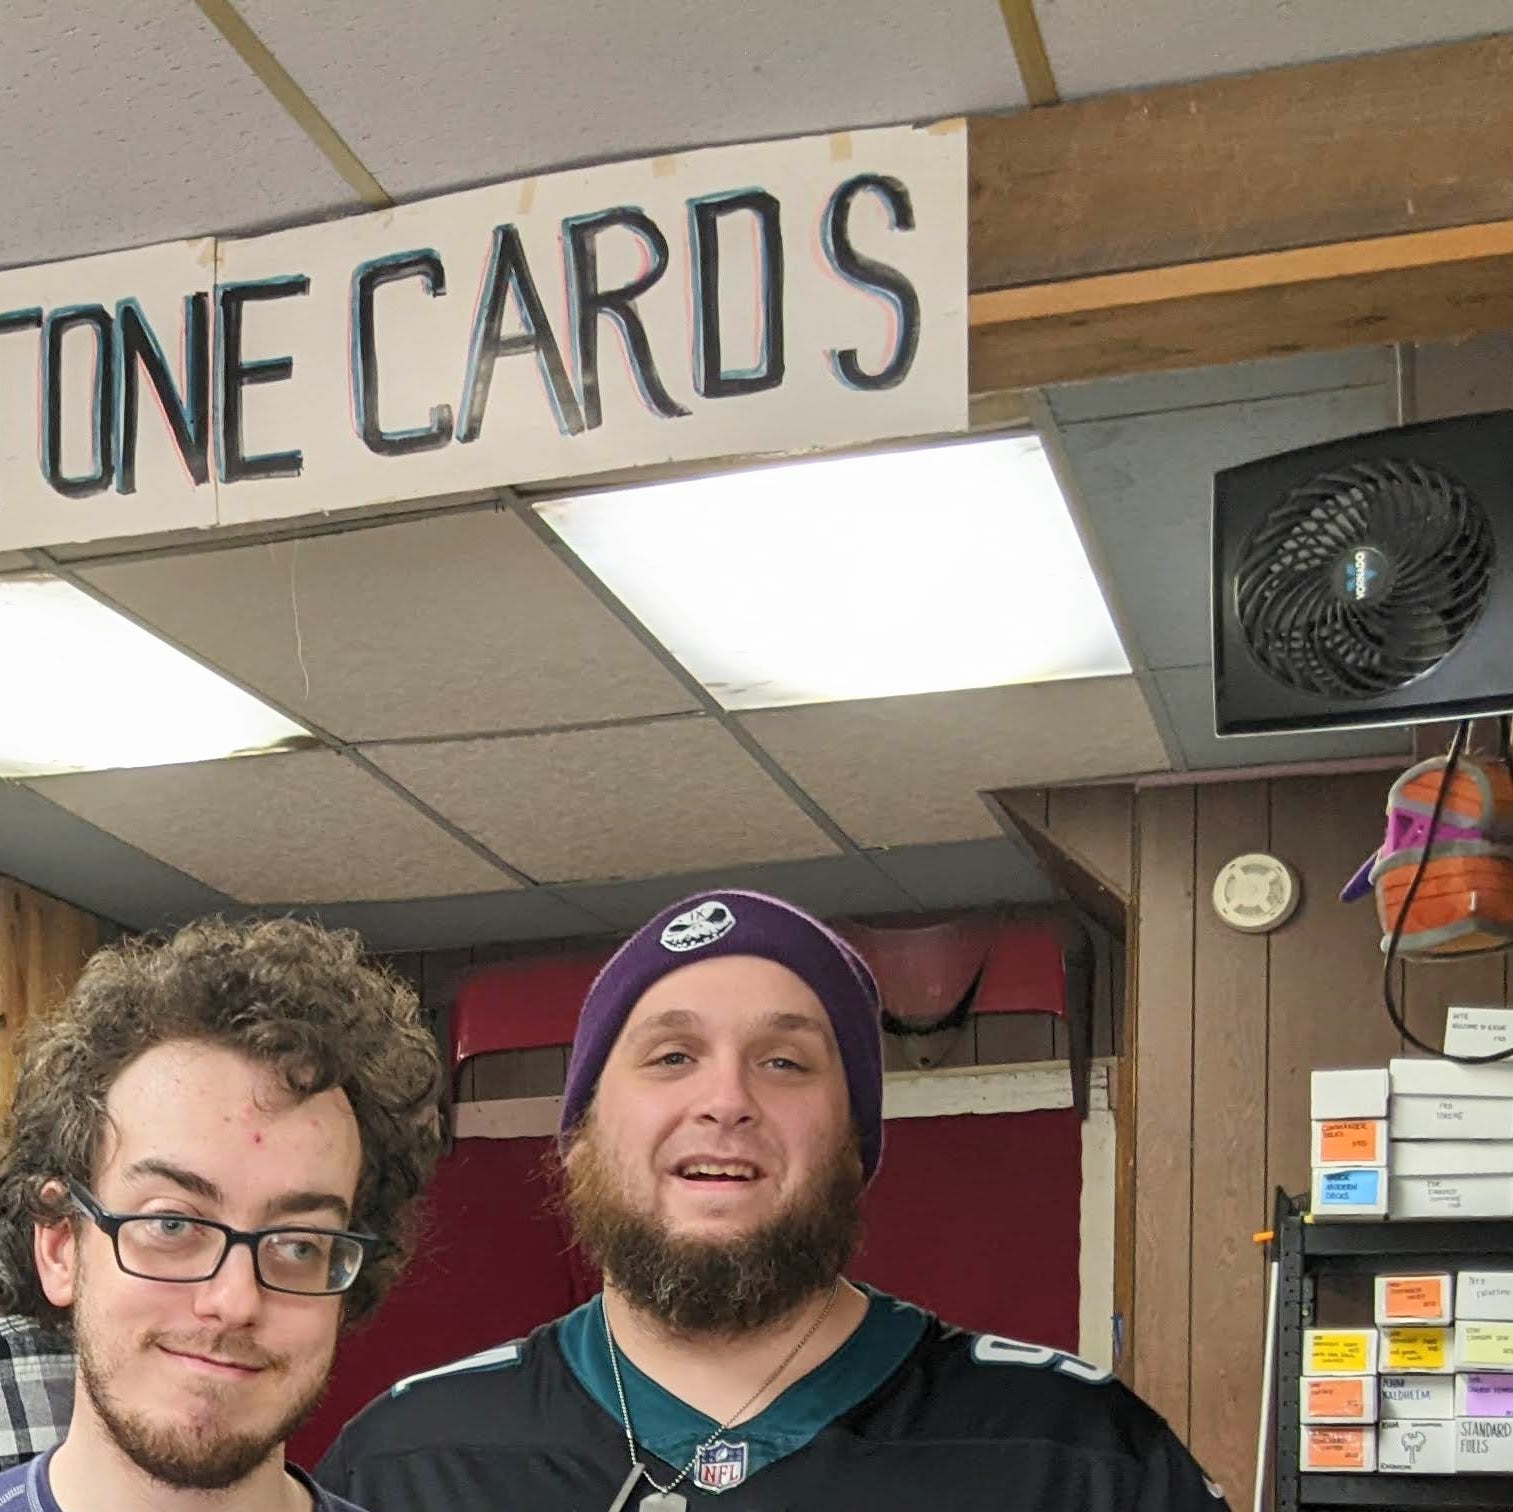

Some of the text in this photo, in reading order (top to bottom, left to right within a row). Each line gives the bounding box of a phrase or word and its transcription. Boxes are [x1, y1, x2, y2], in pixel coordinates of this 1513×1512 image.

[346, 172, 921, 456] CARDS
[1355, 552, 1366, 600] VORNADO
[1460, 1421, 1512, 1438] STANDARD
[702, 1462, 740, 1487] NFL
